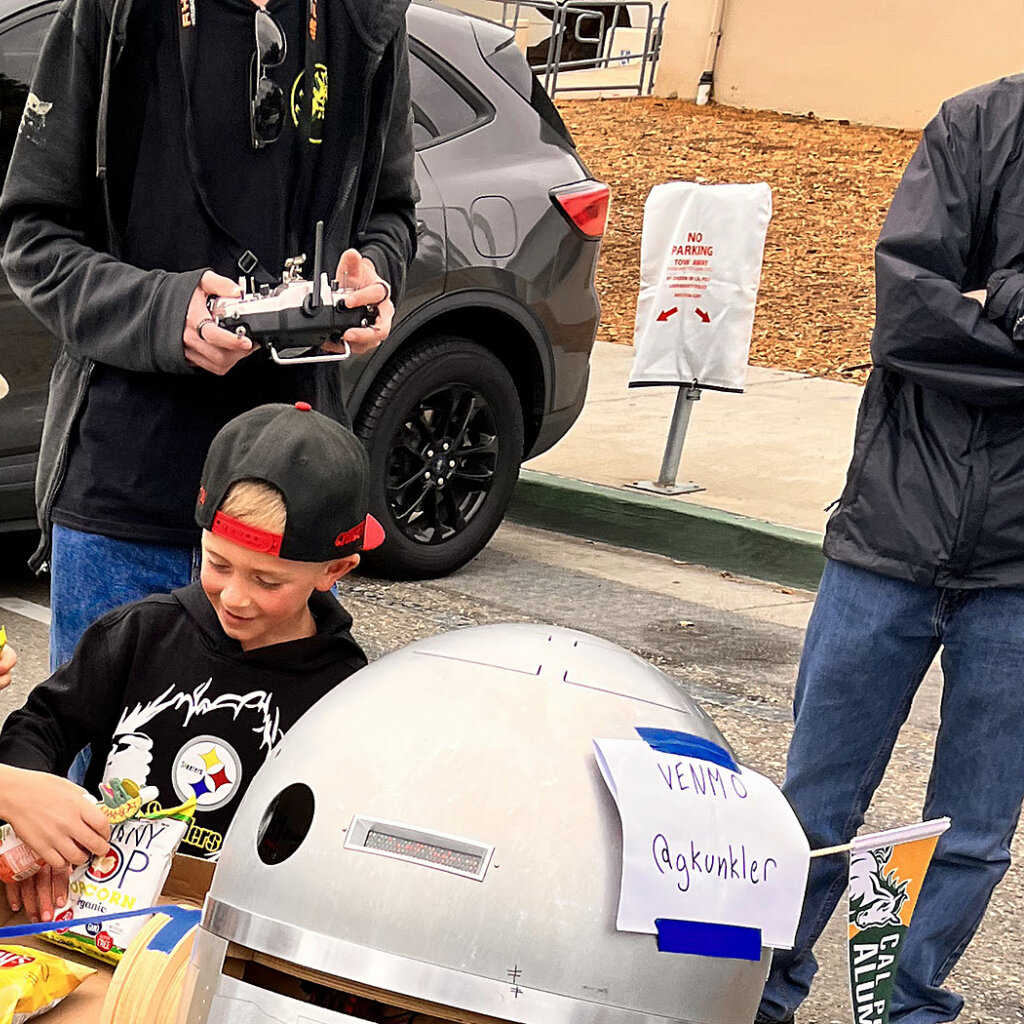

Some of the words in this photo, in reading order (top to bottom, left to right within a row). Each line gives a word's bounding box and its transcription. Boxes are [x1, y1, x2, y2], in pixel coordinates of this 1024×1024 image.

[687, 232, 703, 243] NO
[671, 245, 714, 256] PARKING
[180, 761, 204, 775] Steelers
[657, 762, 748, 799] VENMO
[652, 833, 777, 892] @gkunkler
[70, 881, 136, 910] OPCORN
[76, 898, 107, 913] rganic
[875, 933, 900, 986] CAL
